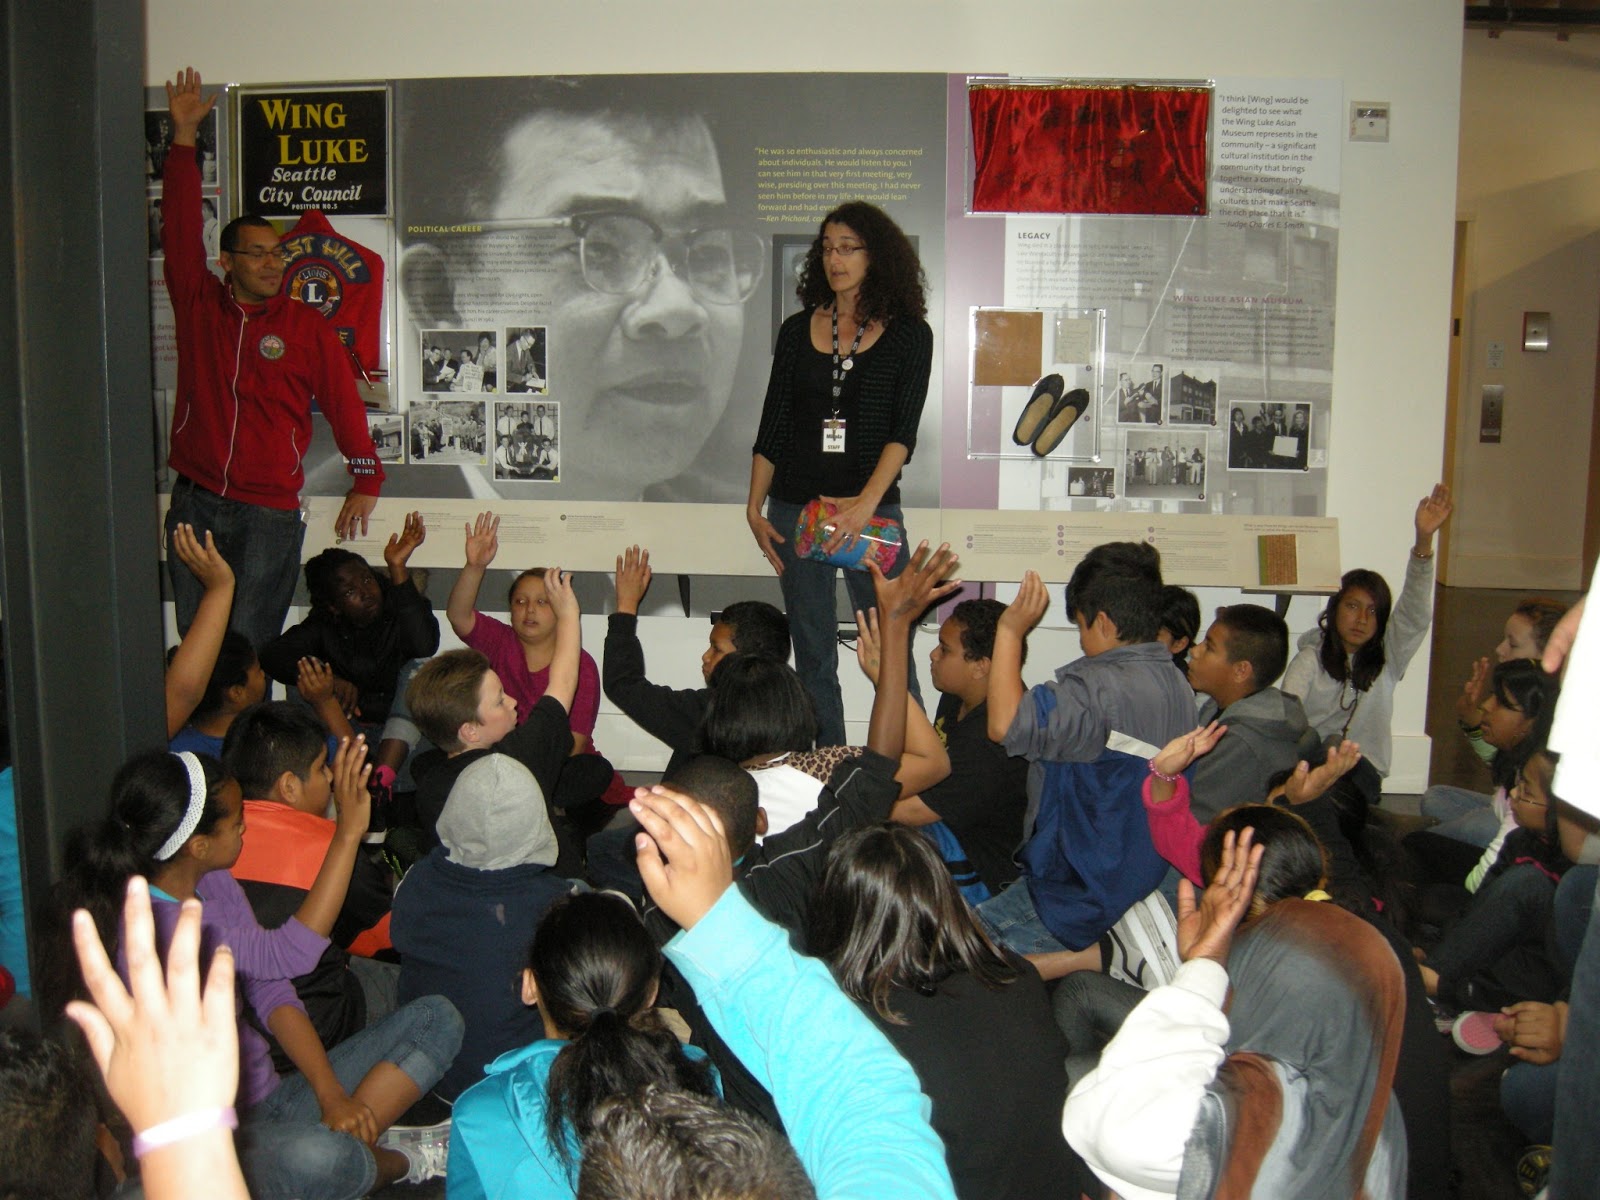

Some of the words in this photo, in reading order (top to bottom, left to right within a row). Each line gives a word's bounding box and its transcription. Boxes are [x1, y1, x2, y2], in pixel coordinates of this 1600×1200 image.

[258, 99, 347, 130] WING
[1222, 106, 1257, 116] delighted
[1236, 118, 1256, 127] Wing
[1256, 131, 1294, 139] represents
[278, 134, 369, 165] LUKE
[1221, 142, 1264, 150] community
[1277, 142, 1316, 151] significant
[858, 148, 883, 156] always
[1300, 153, 1313, 161] the
[272, 166, 337, 183] Seattle
[1220, 165, 1263, 173] community
[1282, 165, 1305, 174] brings
[862, 171, 896, 179] meeting,
[778, 181, 812, 190] presiding
[846, 182, 879, 191] meeting.
[259, 186, 293, 206] City
[301, 184, 362, 202] Council
[302, 269, 329, 279] LIONS
[307, 283, 323, 303] L
